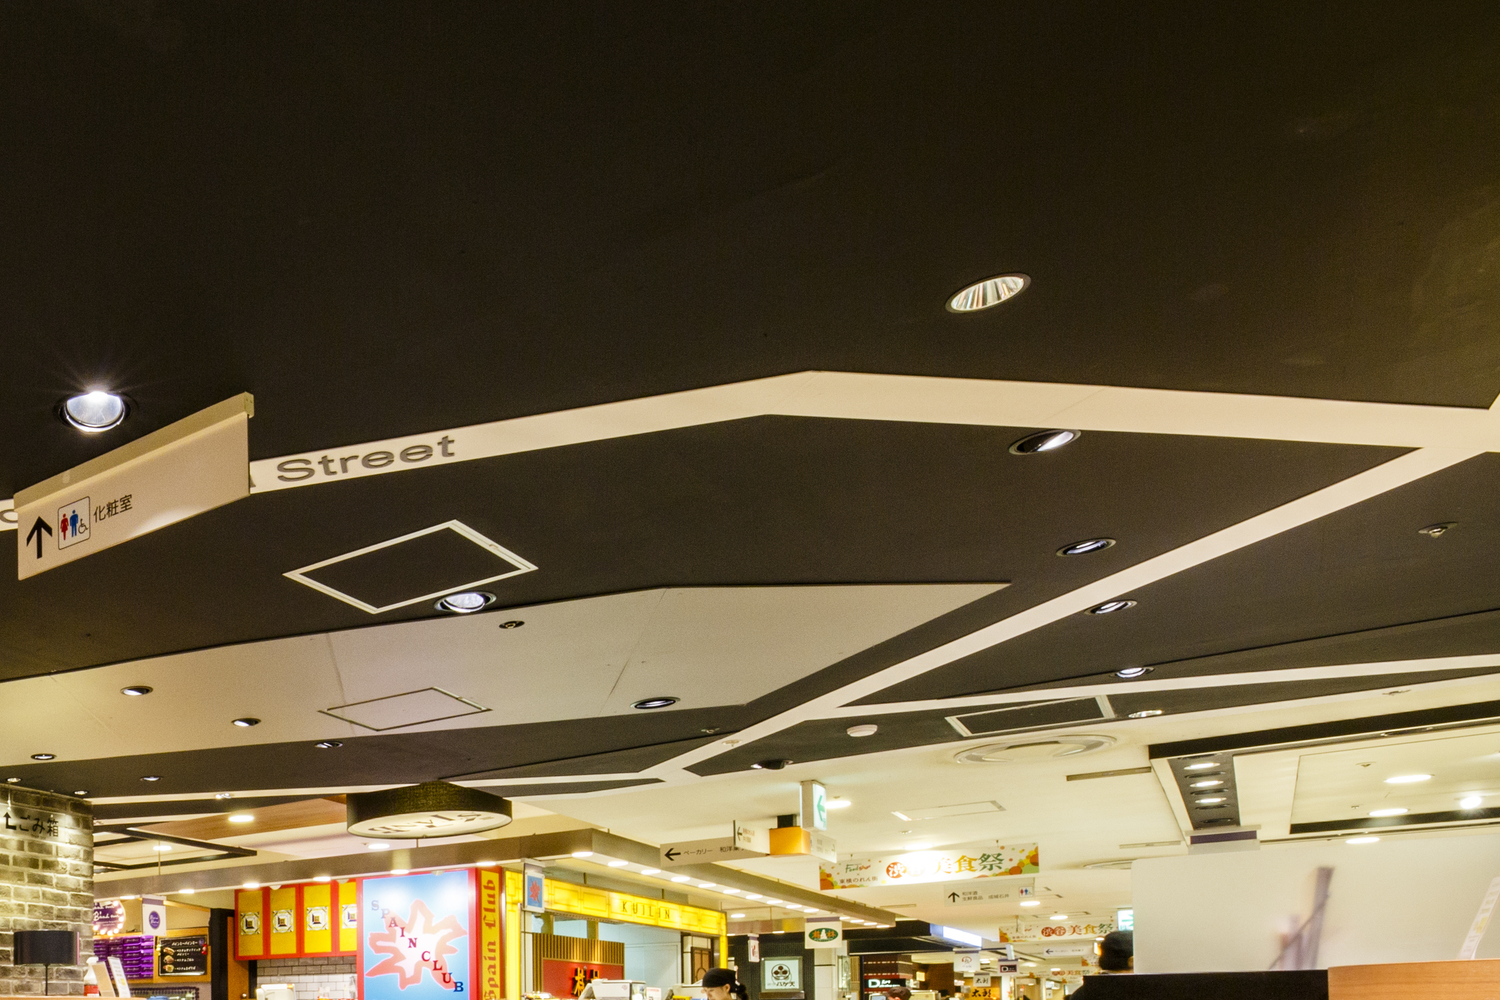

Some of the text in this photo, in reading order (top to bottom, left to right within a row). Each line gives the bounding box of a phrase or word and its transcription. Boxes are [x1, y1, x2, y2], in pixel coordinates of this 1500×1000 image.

[277, 435, 456, 484] Street
[93, 493, 134, 524] 化粧室
[20, 814, 59, 837] ごみ箱
[839, 876, 879, 884] 東横のれん街
[621, 901, 671, 919] KUILIN
[1041, 923, 1114, 938] 渋谷美食祭
[371, 899, 465, 993] SPAIN CLUB
